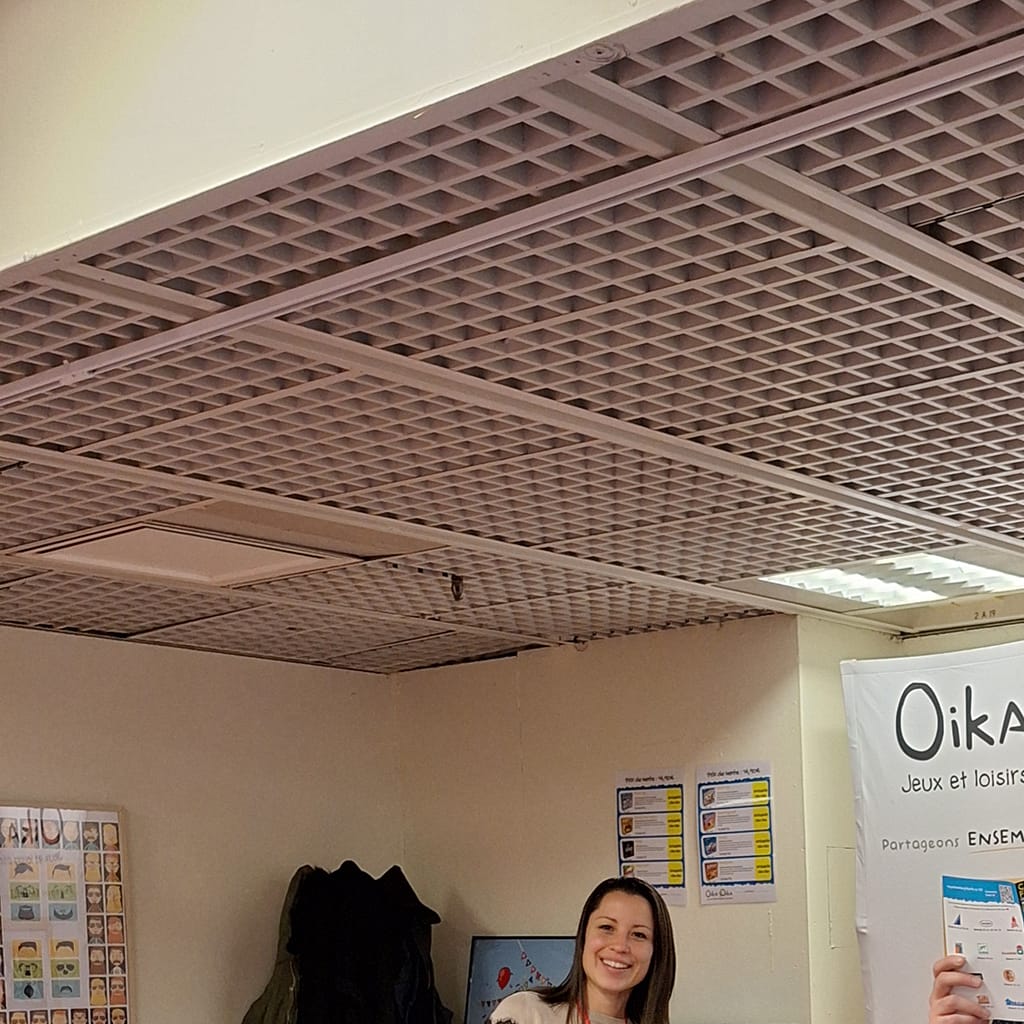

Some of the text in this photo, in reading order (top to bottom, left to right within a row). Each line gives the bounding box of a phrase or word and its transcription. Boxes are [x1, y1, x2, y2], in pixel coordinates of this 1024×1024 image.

[901, 772, 944, 794] Jeux
[949, 770, 968, 791] et
[881, 836, 960, 854] Partageons
